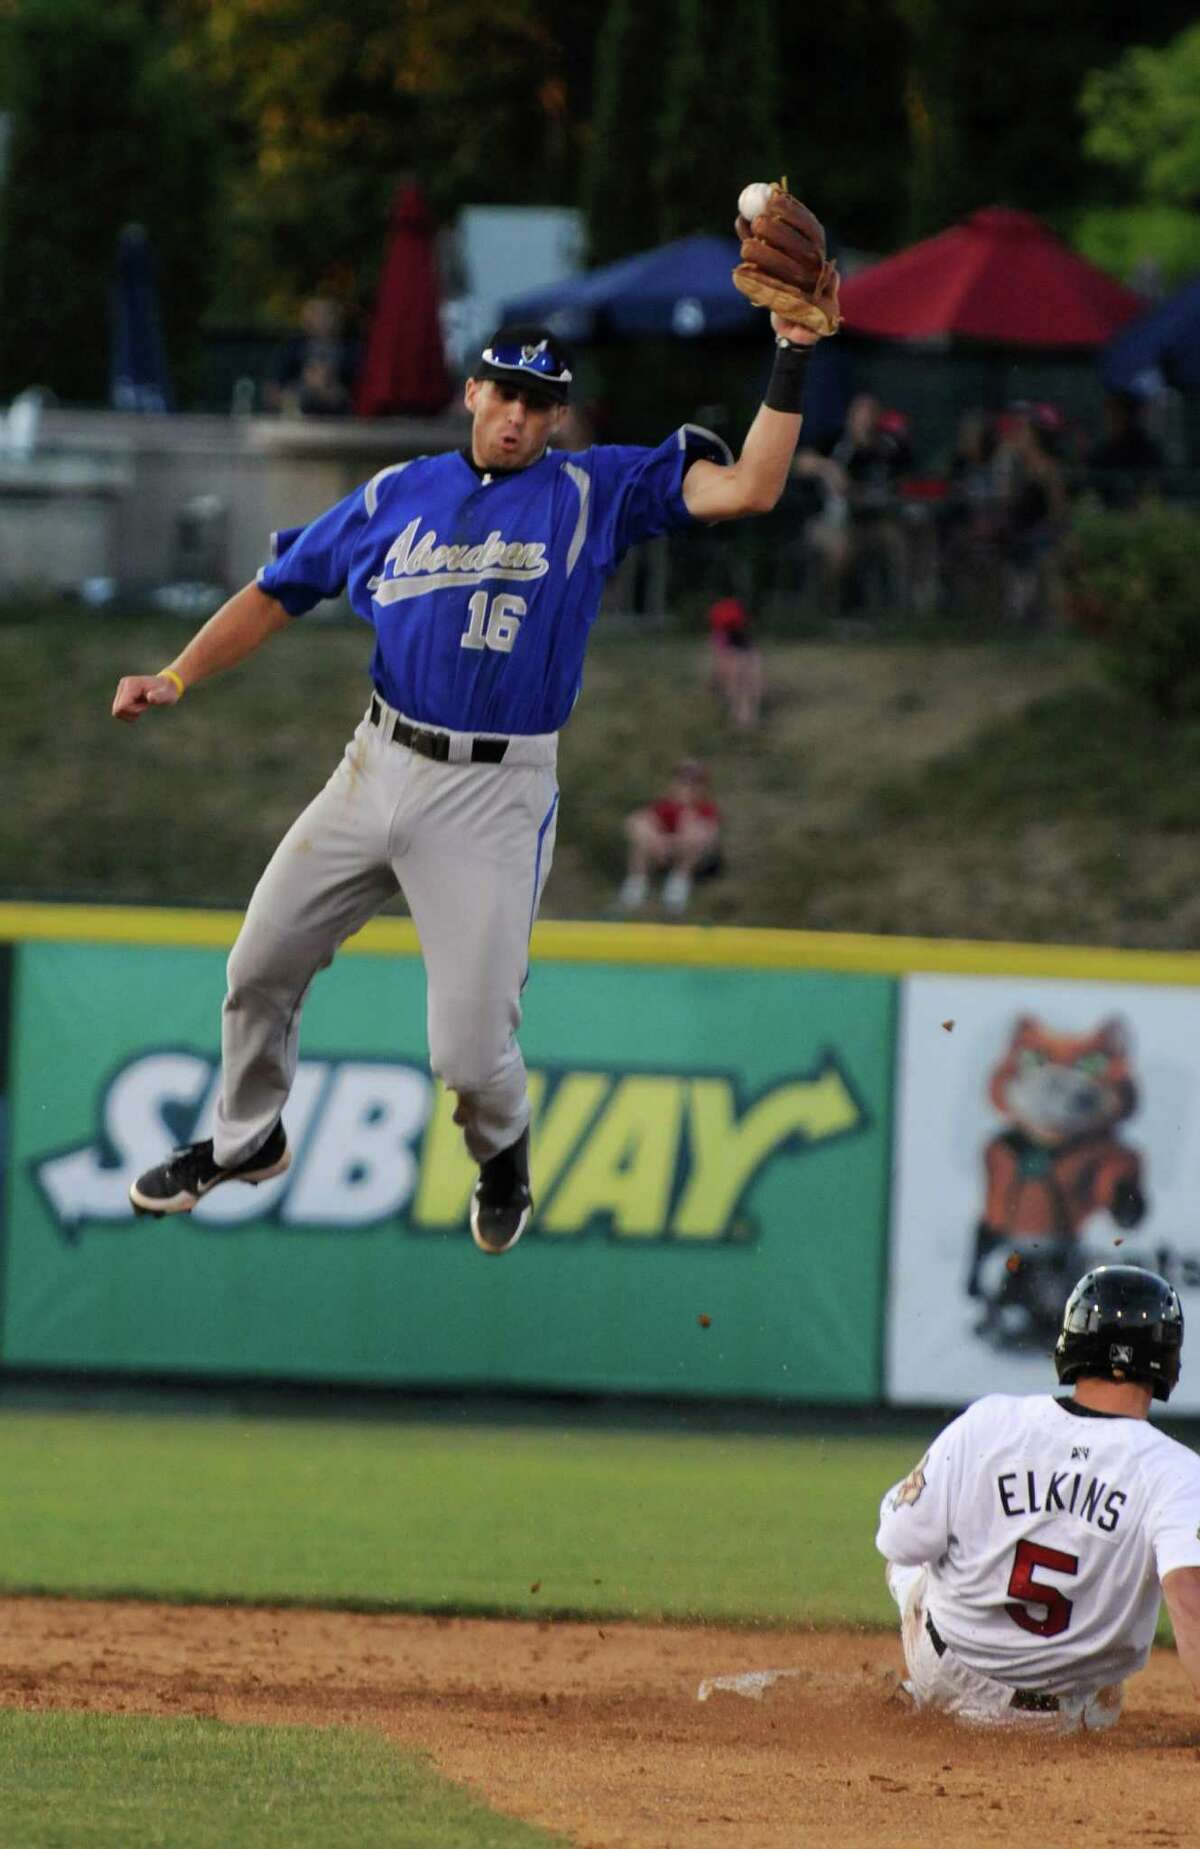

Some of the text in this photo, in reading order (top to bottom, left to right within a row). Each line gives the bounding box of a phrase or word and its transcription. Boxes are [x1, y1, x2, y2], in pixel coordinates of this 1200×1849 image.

[461, 591, 527, 651] 16
[998, 1470, 1127, 1532] ELKINS
[1005, 1539, 1079, 1637] 5
